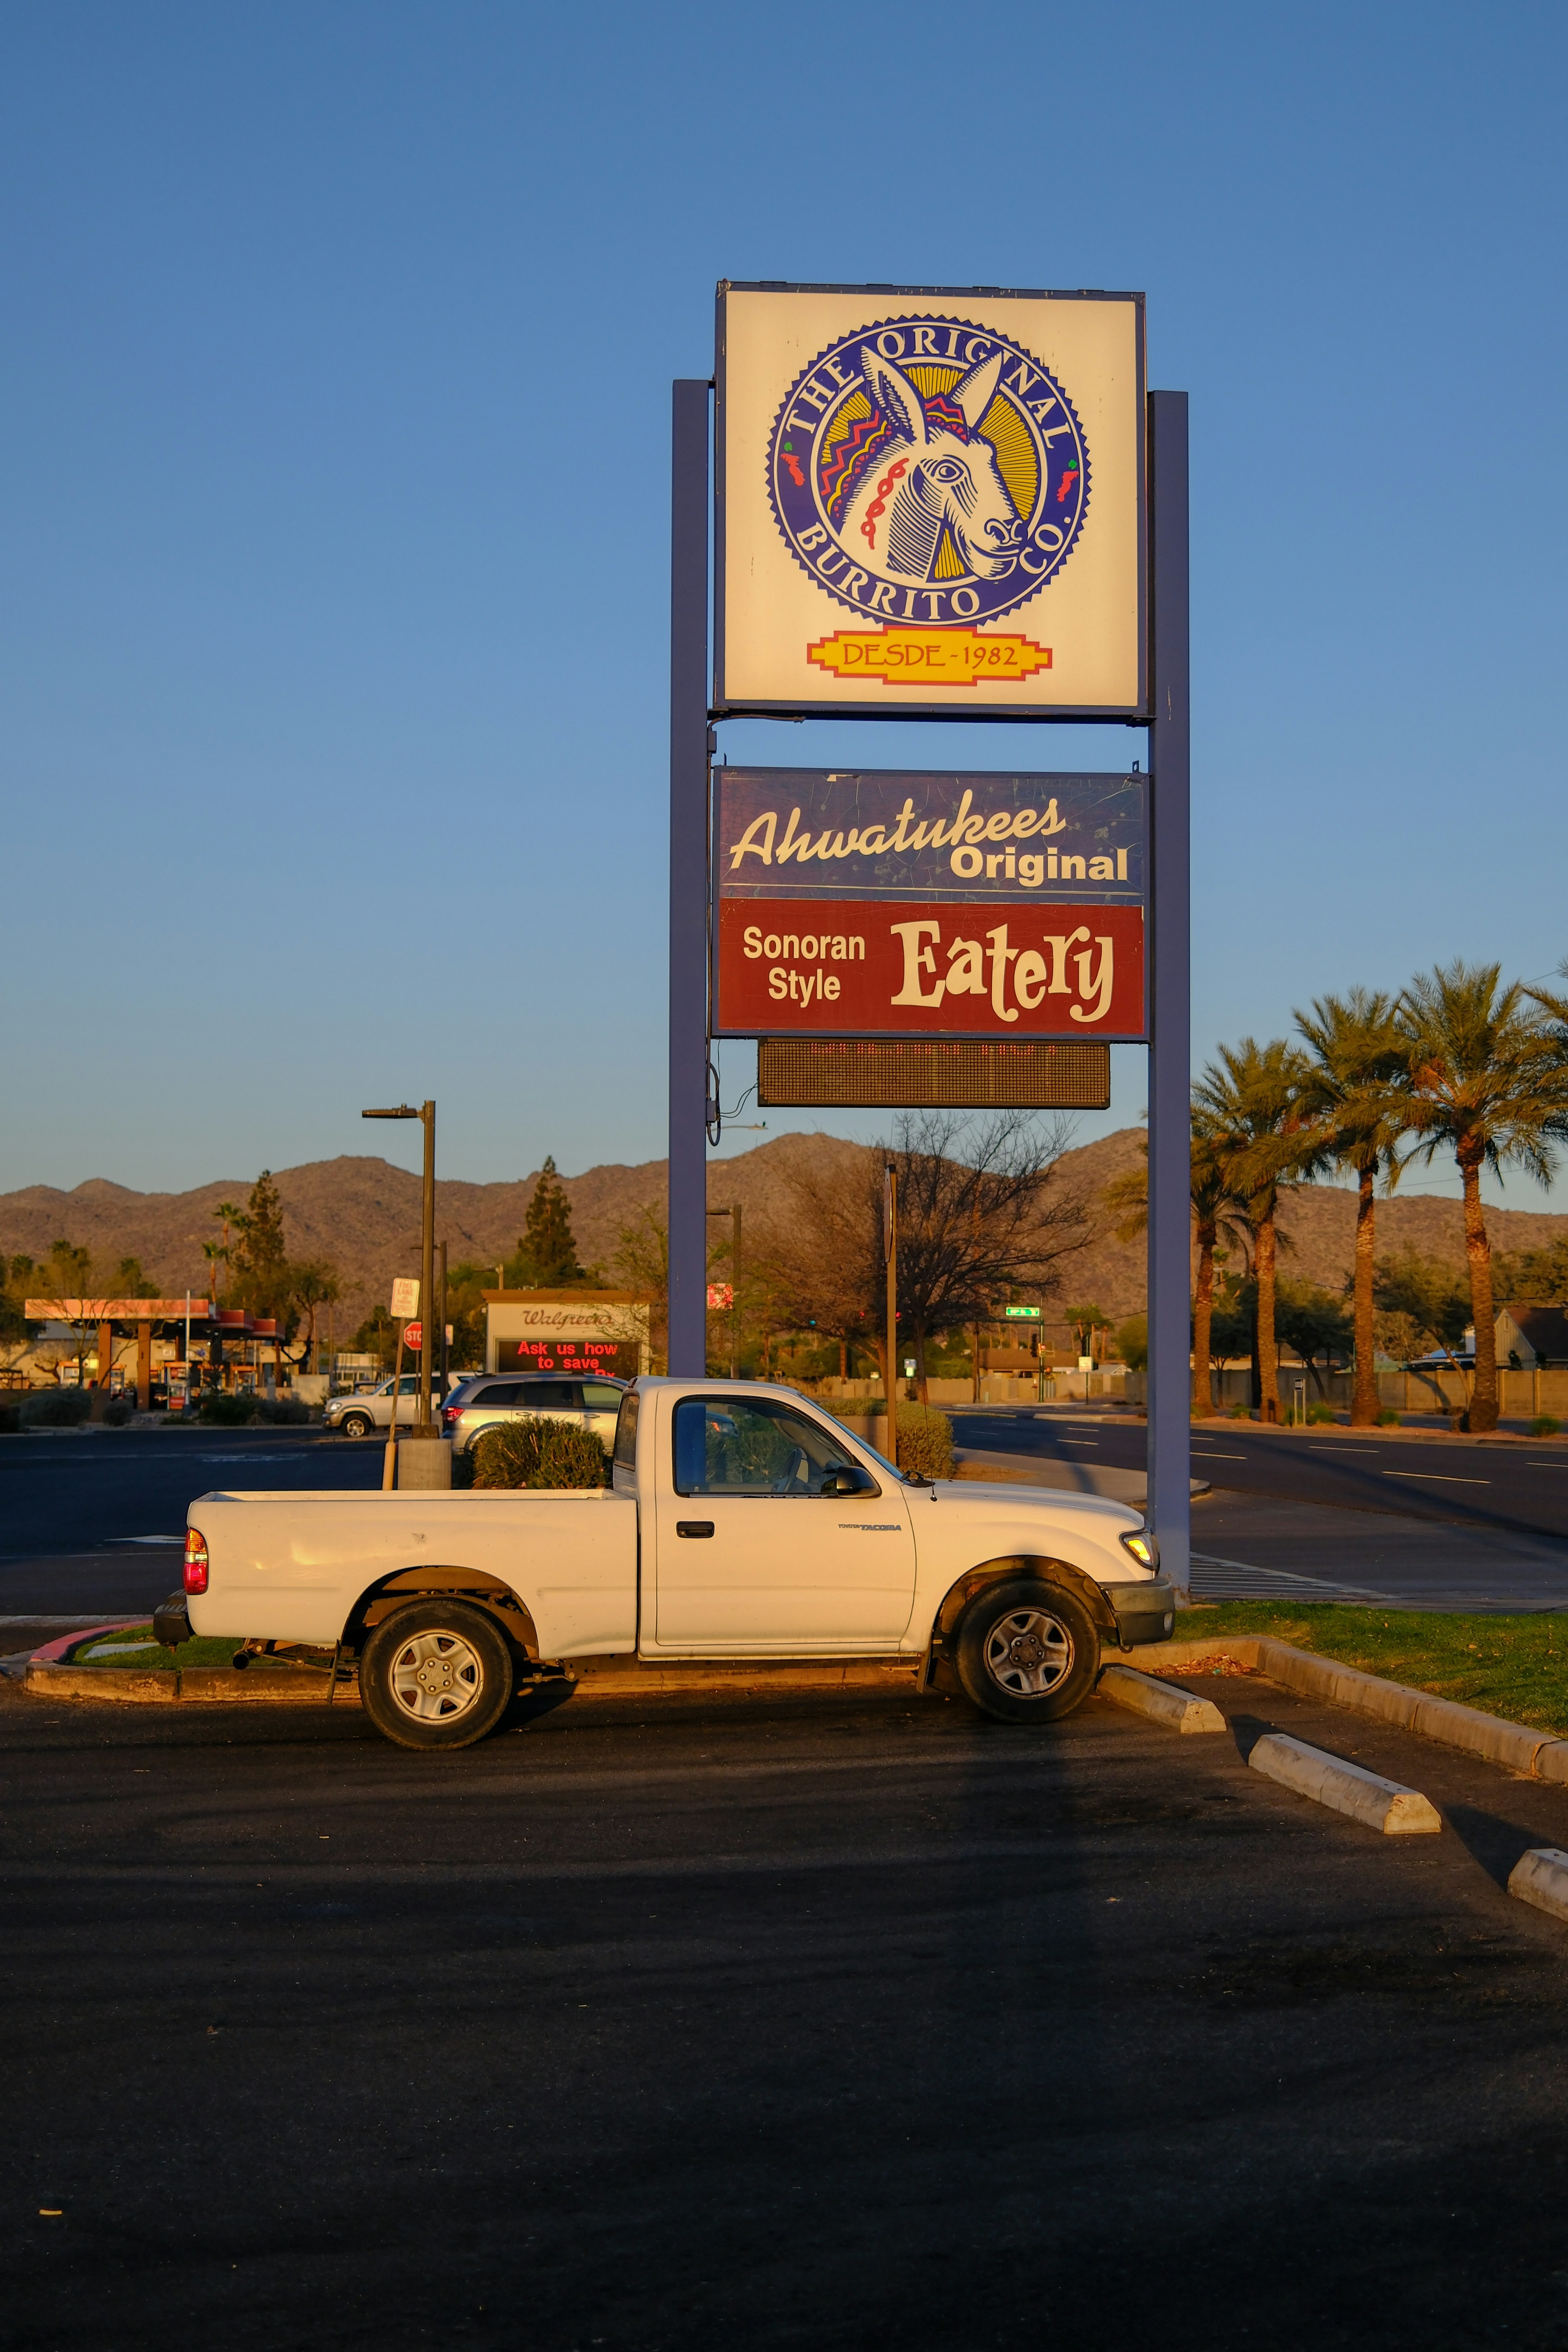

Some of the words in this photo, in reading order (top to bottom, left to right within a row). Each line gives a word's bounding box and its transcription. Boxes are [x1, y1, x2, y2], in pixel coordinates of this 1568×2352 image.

[785, 356, 855, 434] THE
[877, 327, 1071, 449] ORIGNAL
[797, 522, 980, 619] BURRITO
[1019, 517, 1071, 574] CO.
[730, 789, 1066, 869] Ahwatukees
[950, 846, 1127, 887] Original
[743, 926, 865, 960] Sonoran
[768, 967, 840, 1008] Style
[890, 920, 1113, 1022] Eatery
[518, 1341, 548, 1355] Ask
[557, 1344, 575, 1355] us
[584, 1342, 618, 1355] how
[538, 1356, 554, 1369] to
[563, 1358, 600, 1369] save
